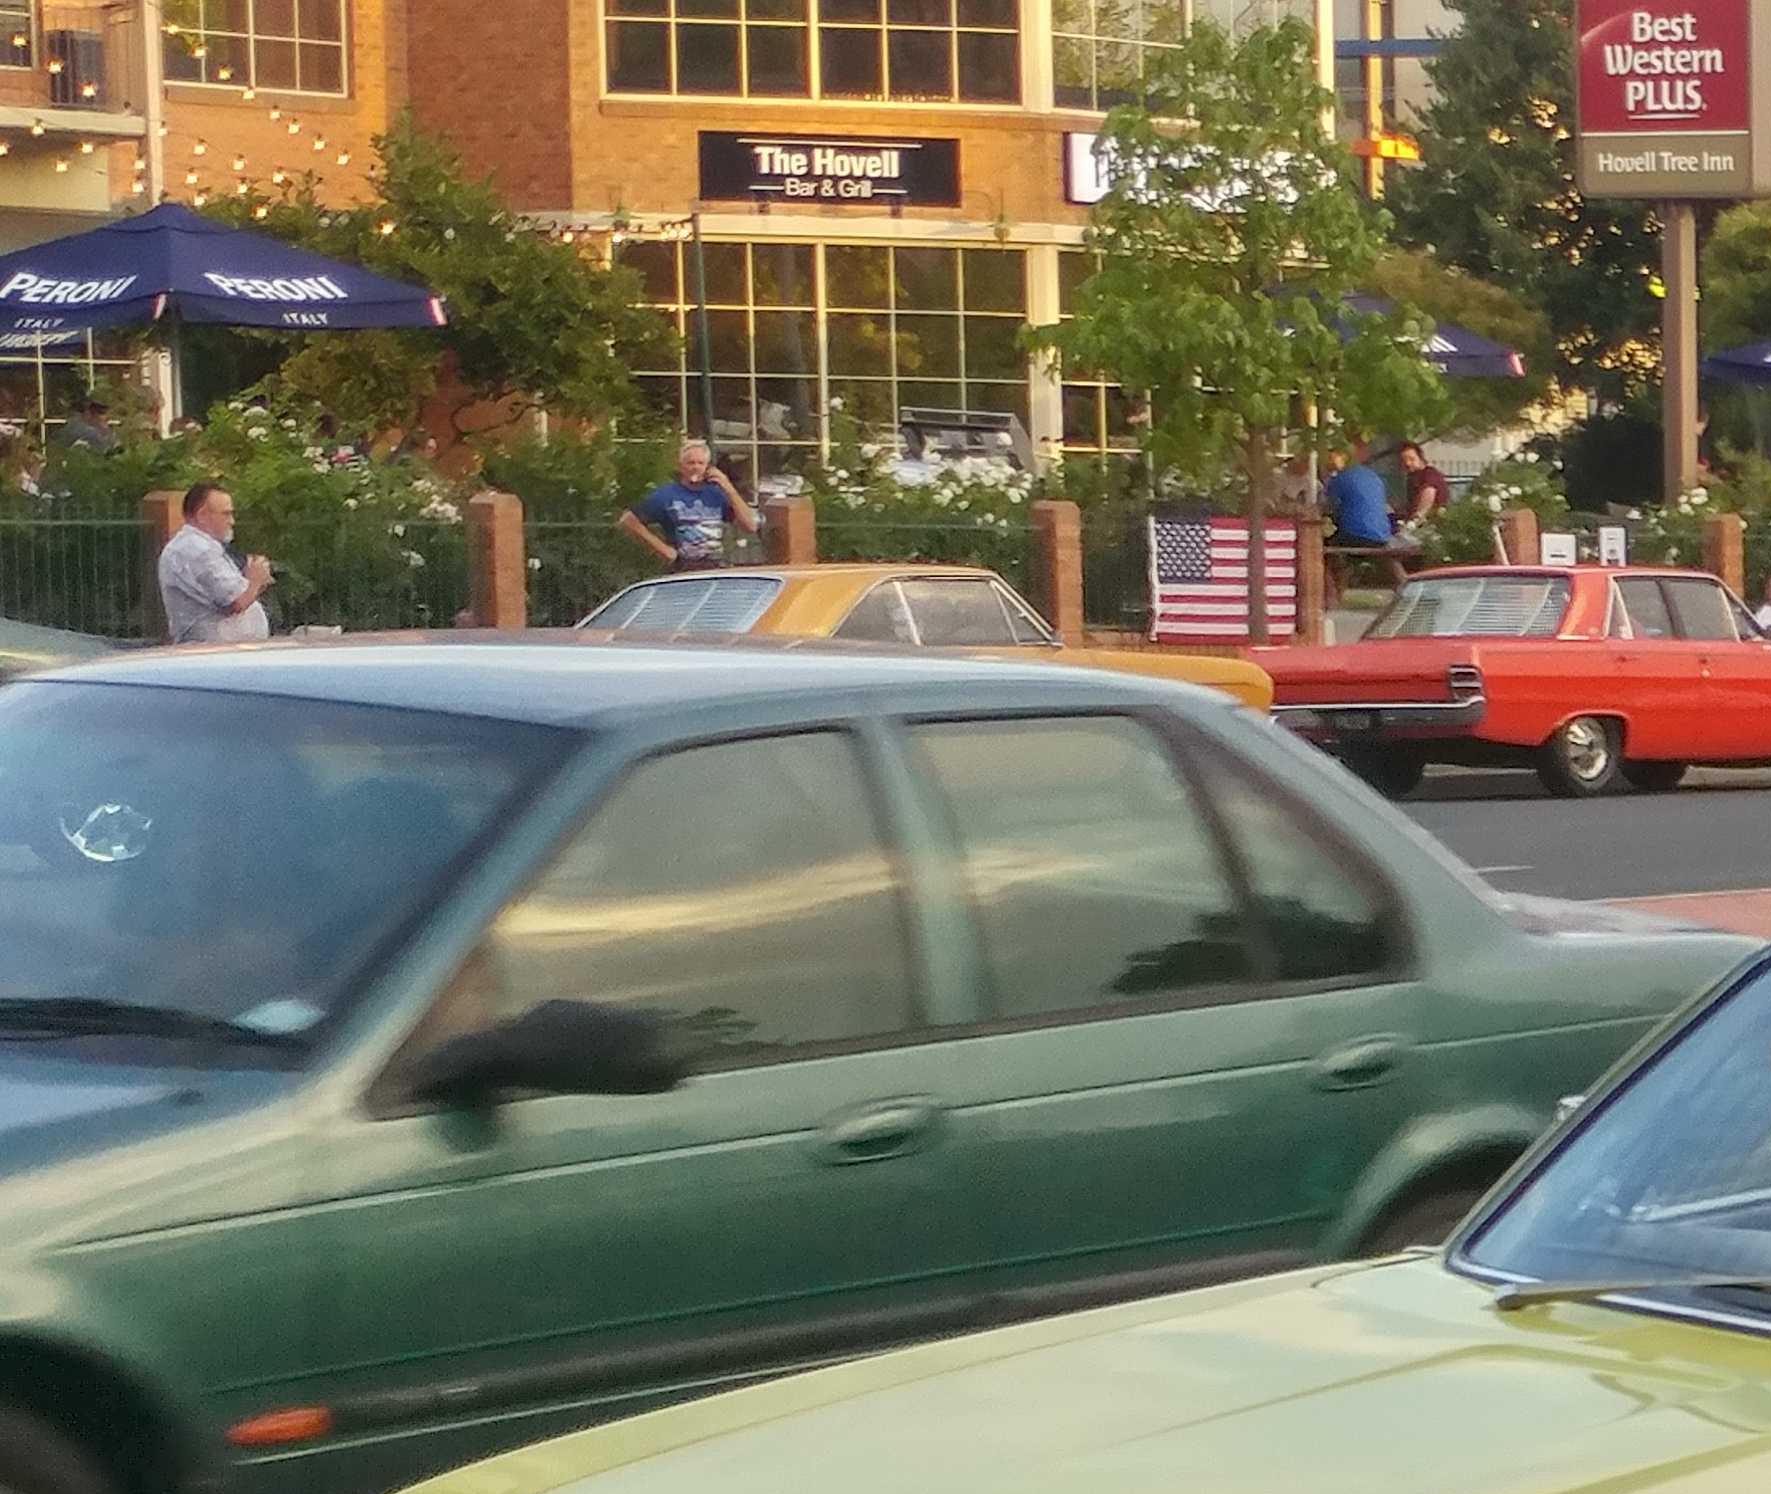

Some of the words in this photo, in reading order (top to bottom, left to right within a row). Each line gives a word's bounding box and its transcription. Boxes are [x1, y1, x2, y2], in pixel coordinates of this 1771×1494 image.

[1632, 11, 1698, 43] Best
[1604, 44, 1724, 75] Western
[753, 146, 808, 175] The
[814, 148, 899, 178] Hovell
[1598, 152, 1656, 172] Hovell
[1660, 153, 1699, 172] Tree
[1703, 152, 1734, 172] Inn
[785, 178, 818, 196] Bar
[821, 179, 837, 197] &
[840, 179, 872, 198] Grill
[0, 271, 138, 303] PERONI
[203, 271, 349, 301] PERONI
[281, 311, 328, 326] ITALY
